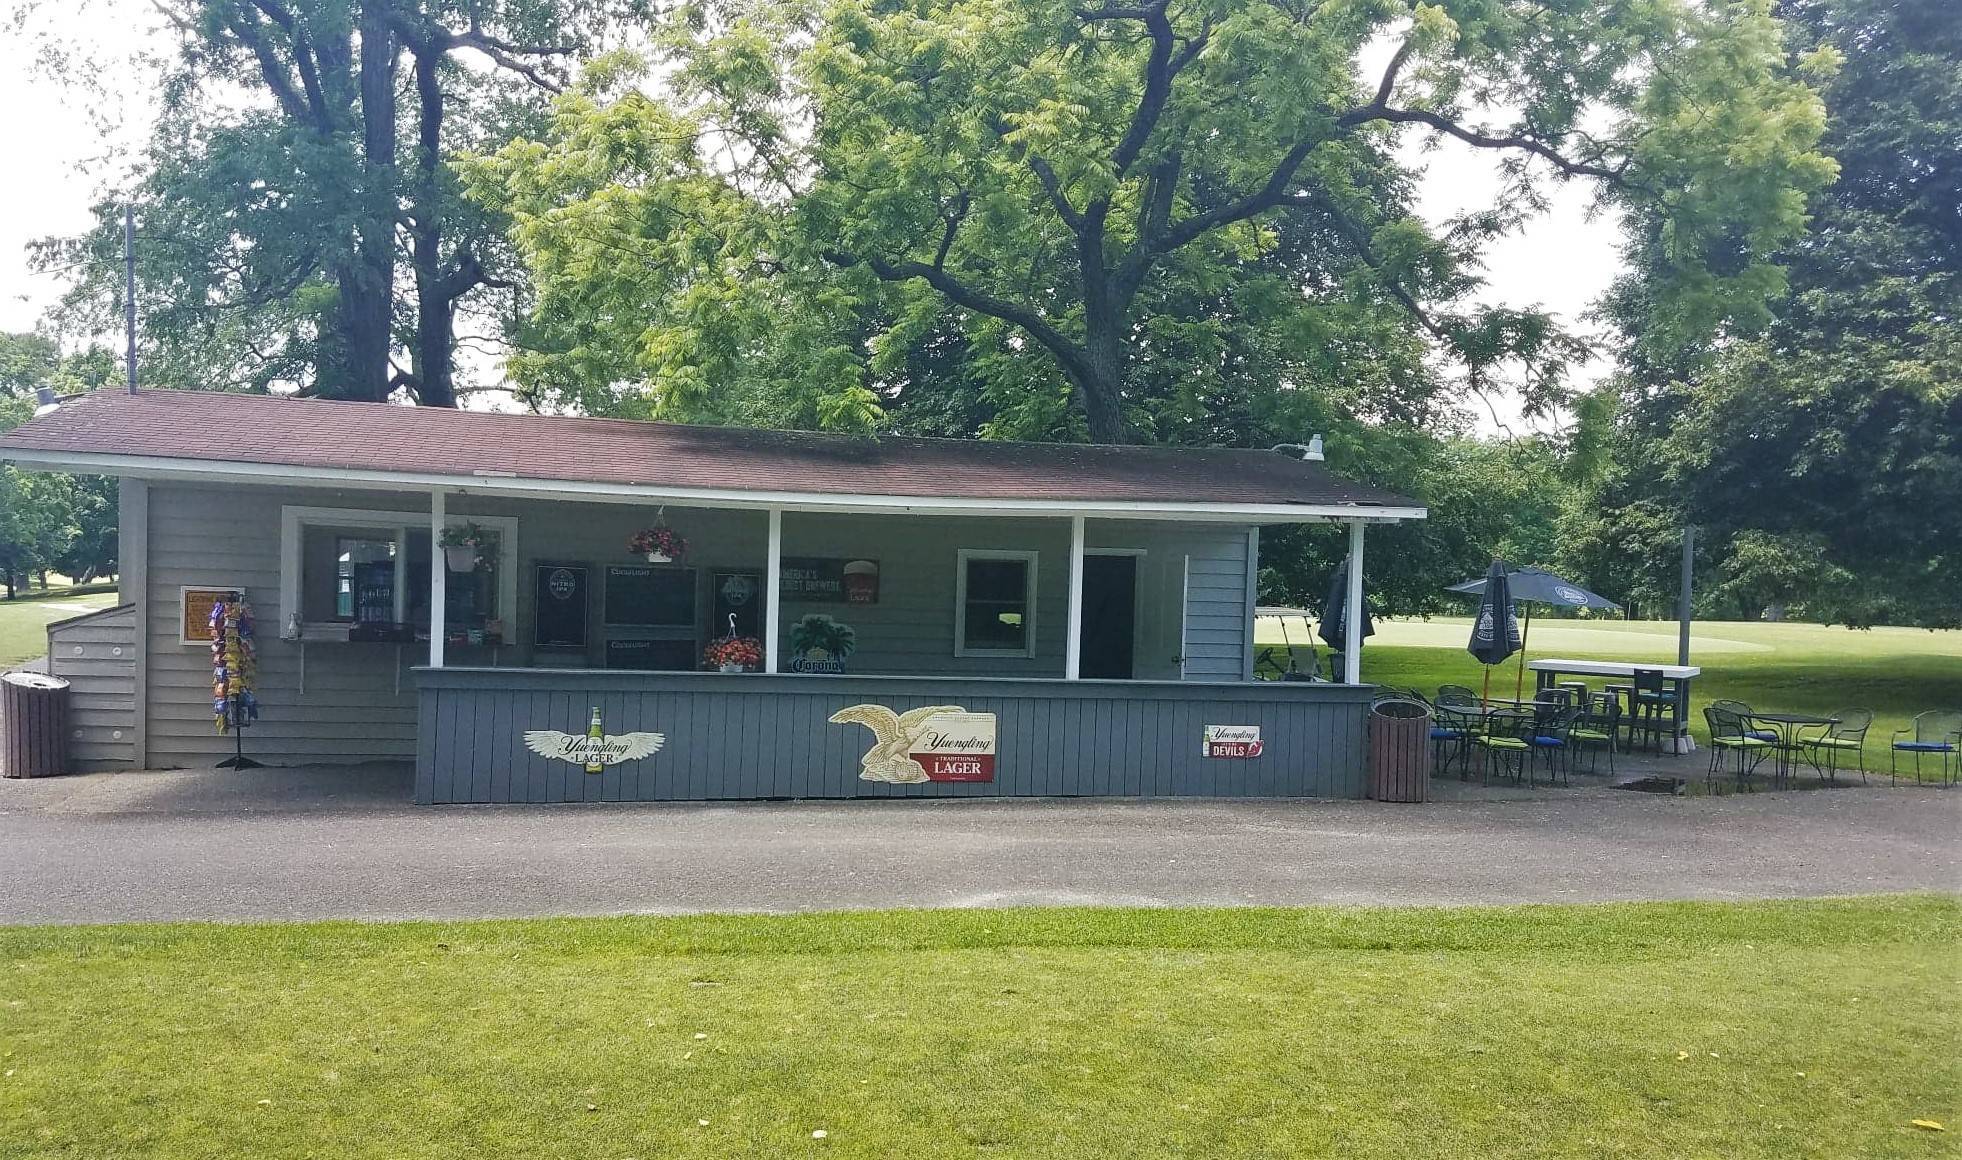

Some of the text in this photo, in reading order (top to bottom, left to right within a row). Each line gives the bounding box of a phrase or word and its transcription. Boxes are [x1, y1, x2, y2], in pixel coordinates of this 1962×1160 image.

[793, 658, 841, 673] Corona
[1210, 727, 1258, 741] Yuengling
[558, 736, 633, 755] Yuengling
[924, 731, 994, 753] Yuengling
[1213, 745, 1245, 756] DEVILS
[575, 753, 614, 763] LAGER
[934, 761, 981, 774] LAGER
